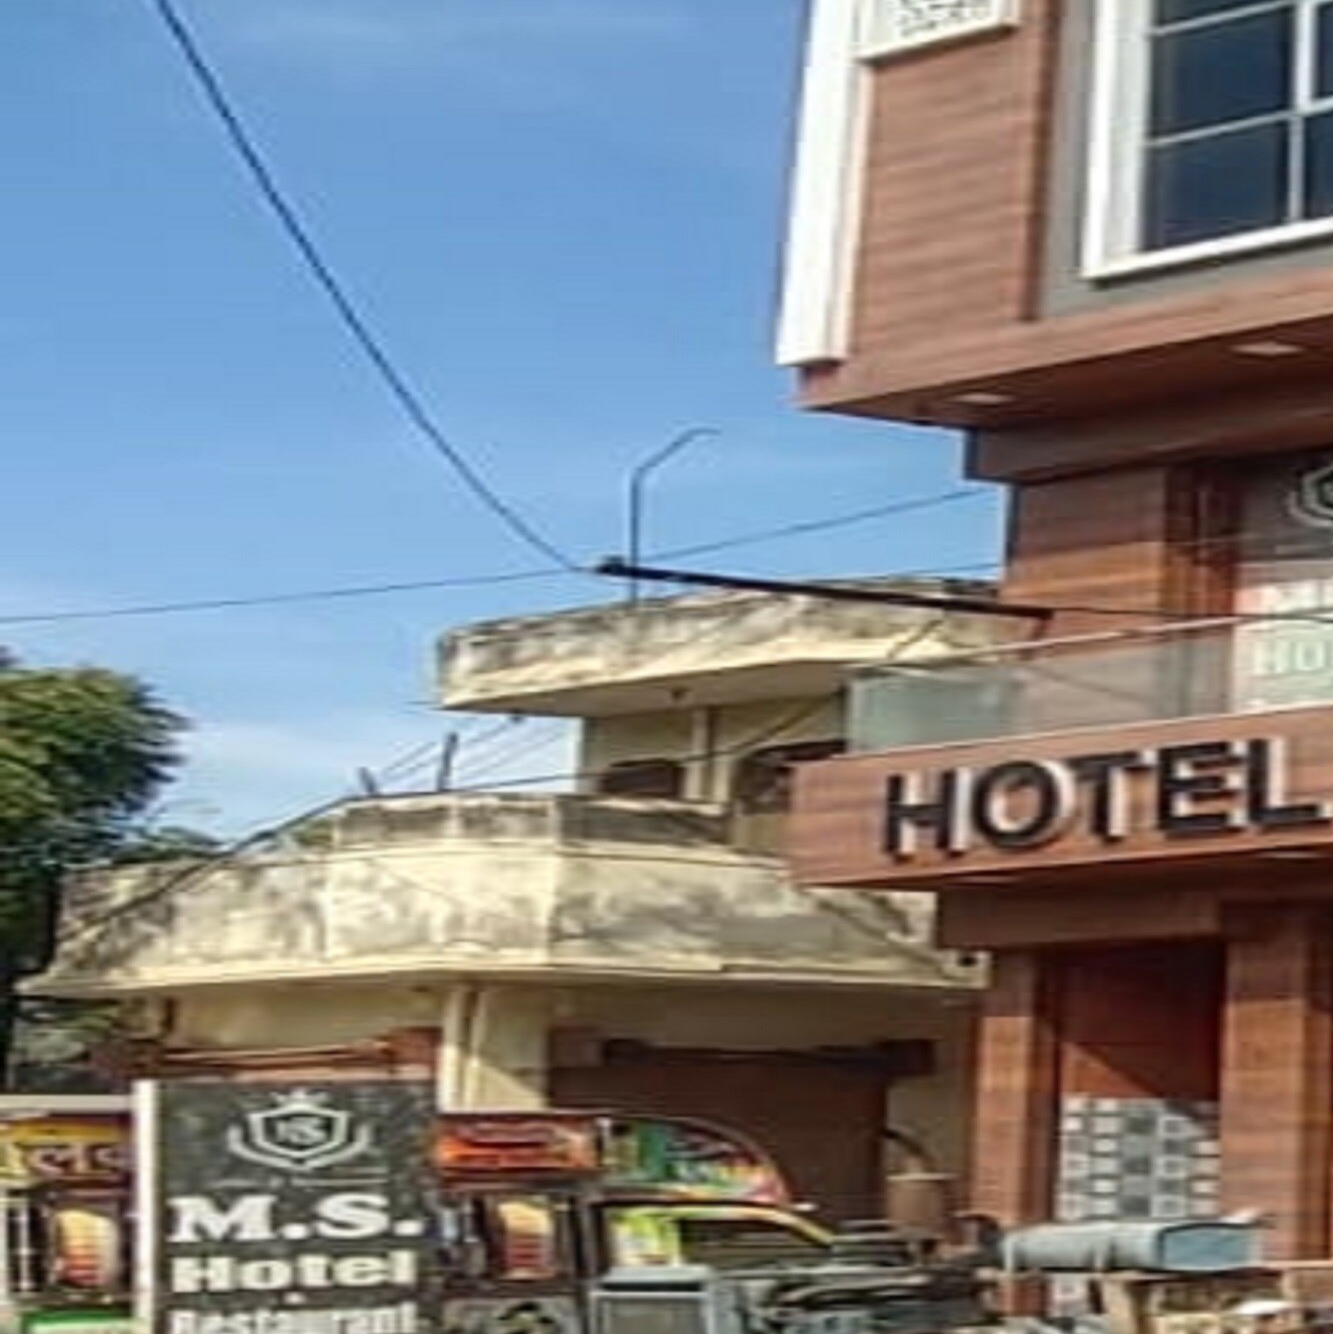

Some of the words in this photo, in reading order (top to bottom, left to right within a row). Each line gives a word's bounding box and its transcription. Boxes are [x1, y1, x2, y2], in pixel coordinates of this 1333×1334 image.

[883, 735, 1333, 858] HOTEL
[168, 1192, 424, 1243] M.S.
[172, 1250, 415, 1294] Hotel
